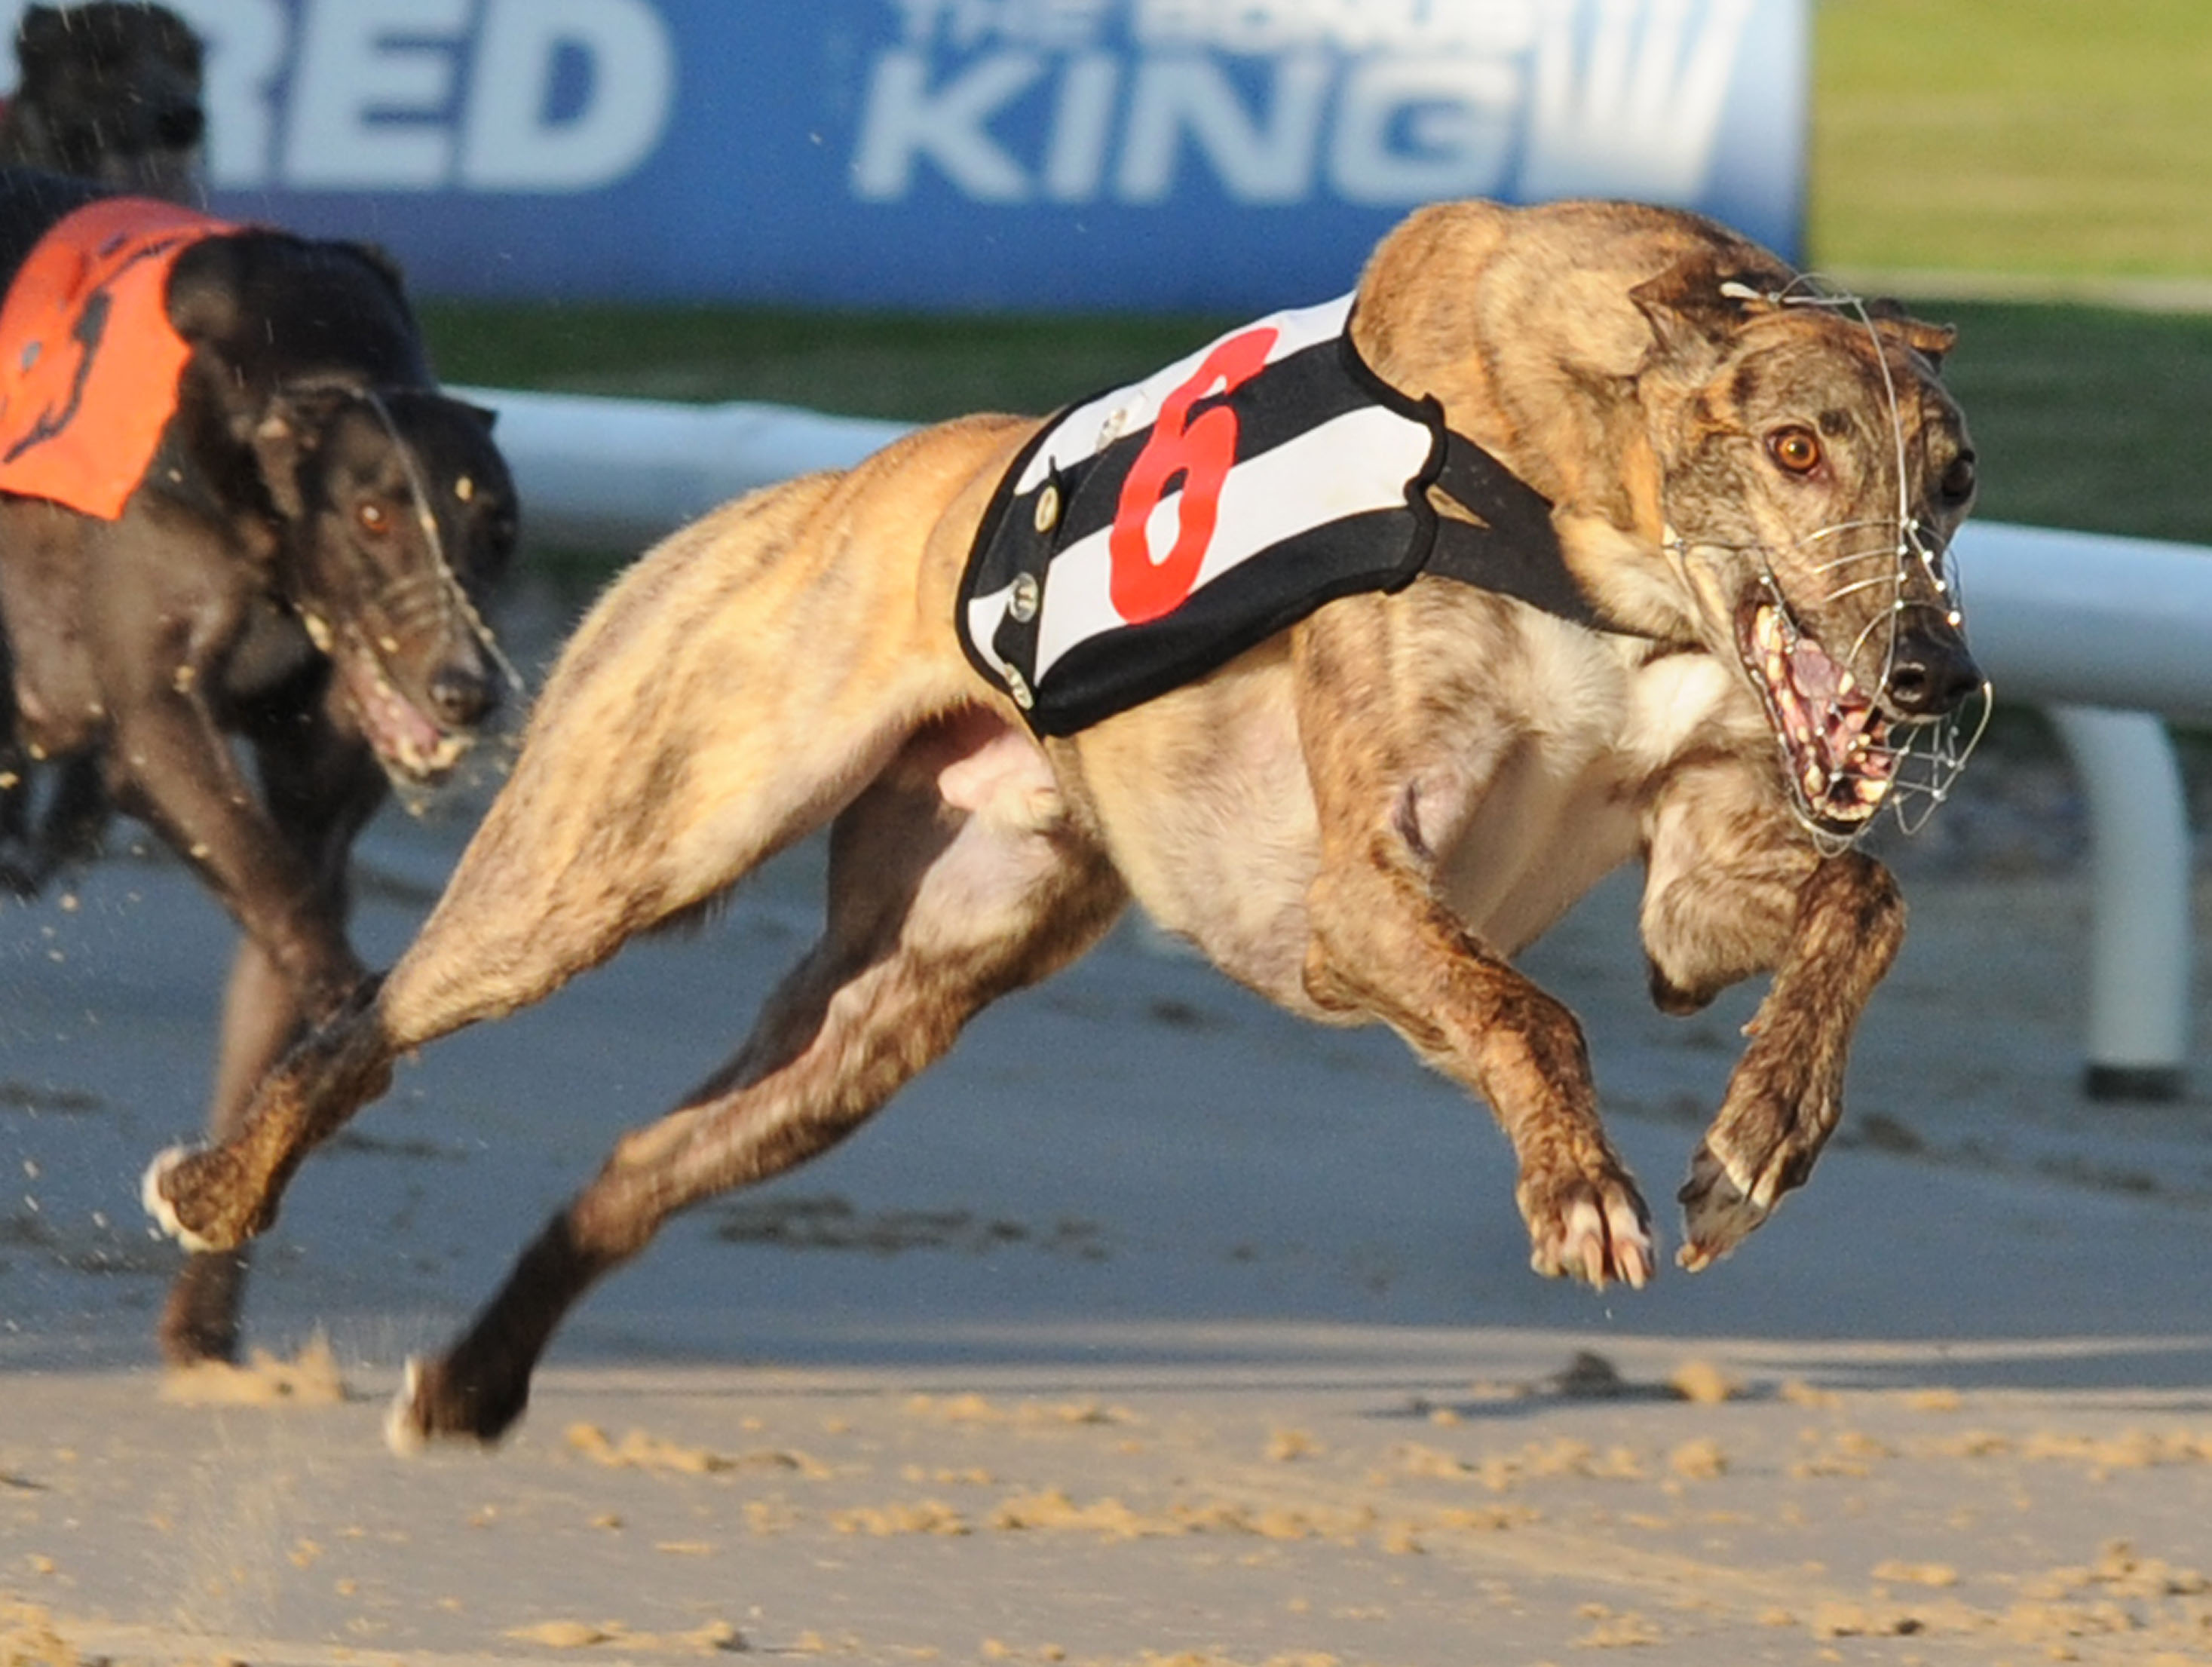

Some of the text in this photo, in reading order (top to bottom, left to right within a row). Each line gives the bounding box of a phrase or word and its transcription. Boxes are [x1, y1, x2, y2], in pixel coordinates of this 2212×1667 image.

[0, 0, 674, 190] RED
[853, 51, 1523, 204] KING
[1109, 327, 1279, 625] 6
